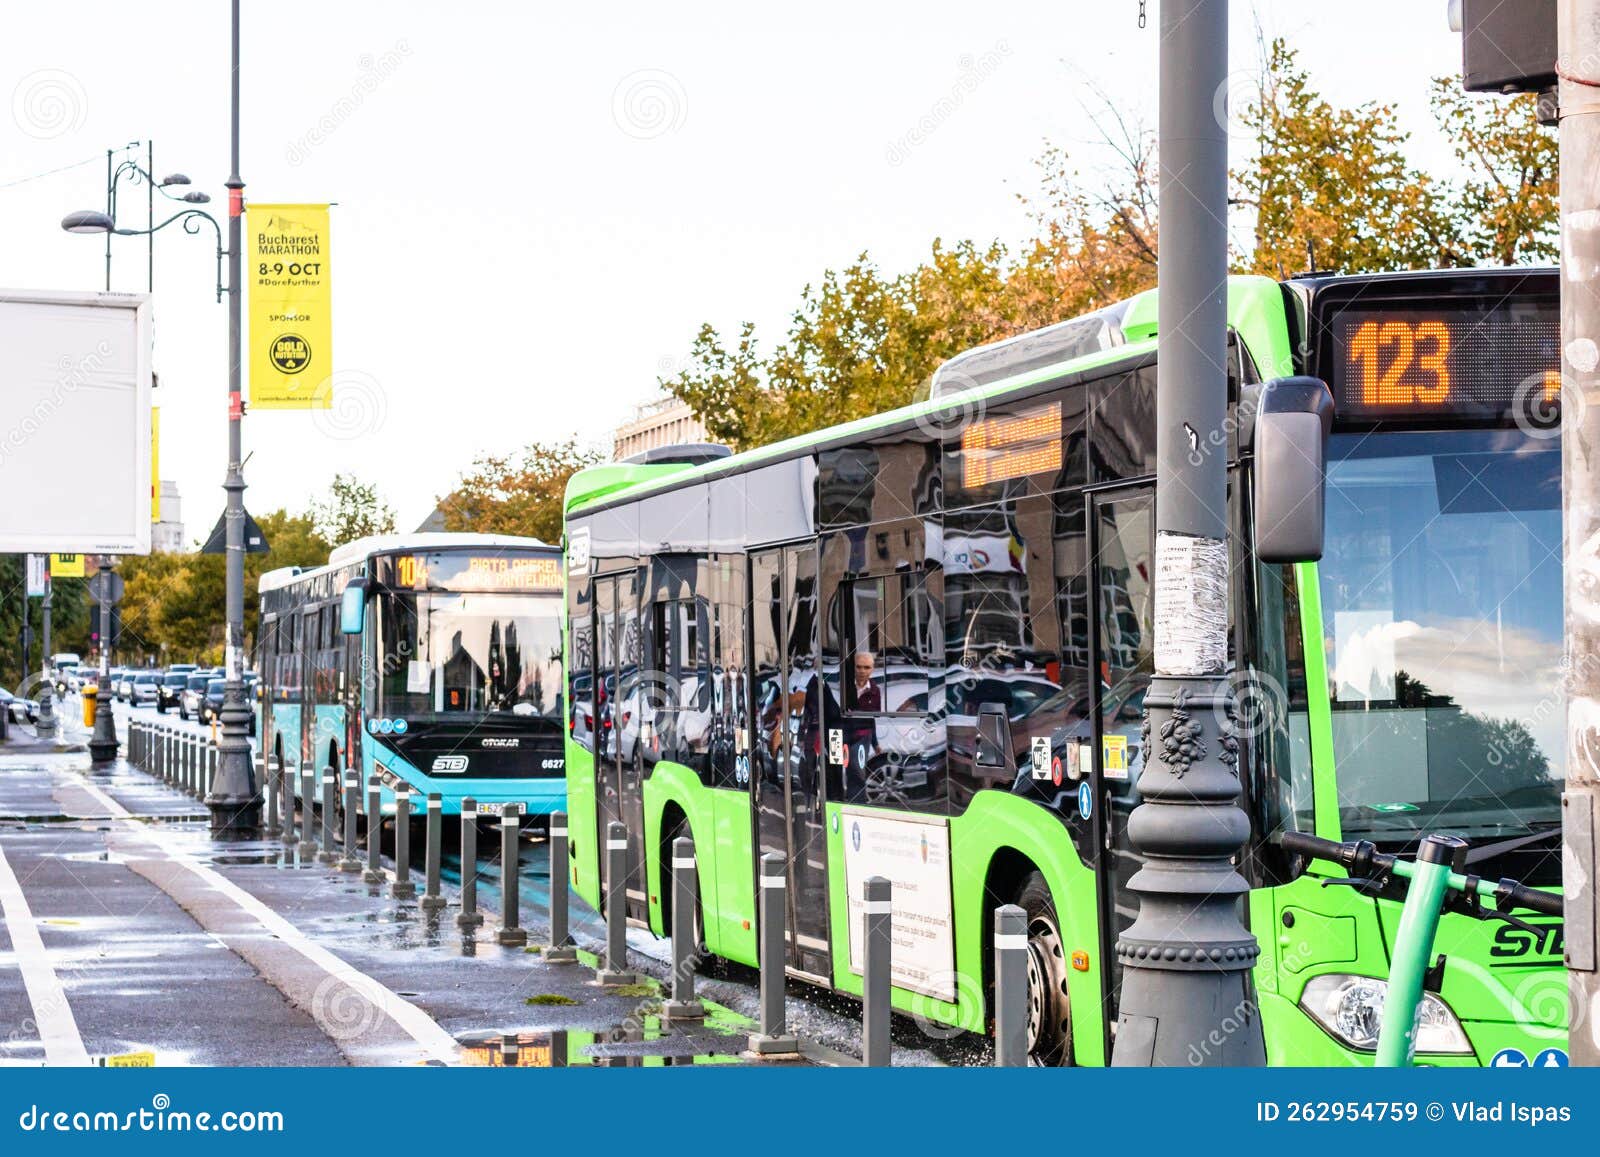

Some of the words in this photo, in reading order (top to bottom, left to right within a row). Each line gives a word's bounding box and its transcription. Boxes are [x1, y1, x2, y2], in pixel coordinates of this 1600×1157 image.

[258, 233, 318, 244] Bucharest
[259, 245, 319, 255] MARATHON
[259, 263, 283, 275] 8-9
[289, 263, 320, 275] OCT
[277, 341, 304, 352] GOLD
[1351, 322, 1449, 403] 123
[398, 557, 428, 587] 104
[482, 739, 519, 747] OTOKAR
[432, 757, 467, 772] STB
[542, 760, 564, 768] 6627
